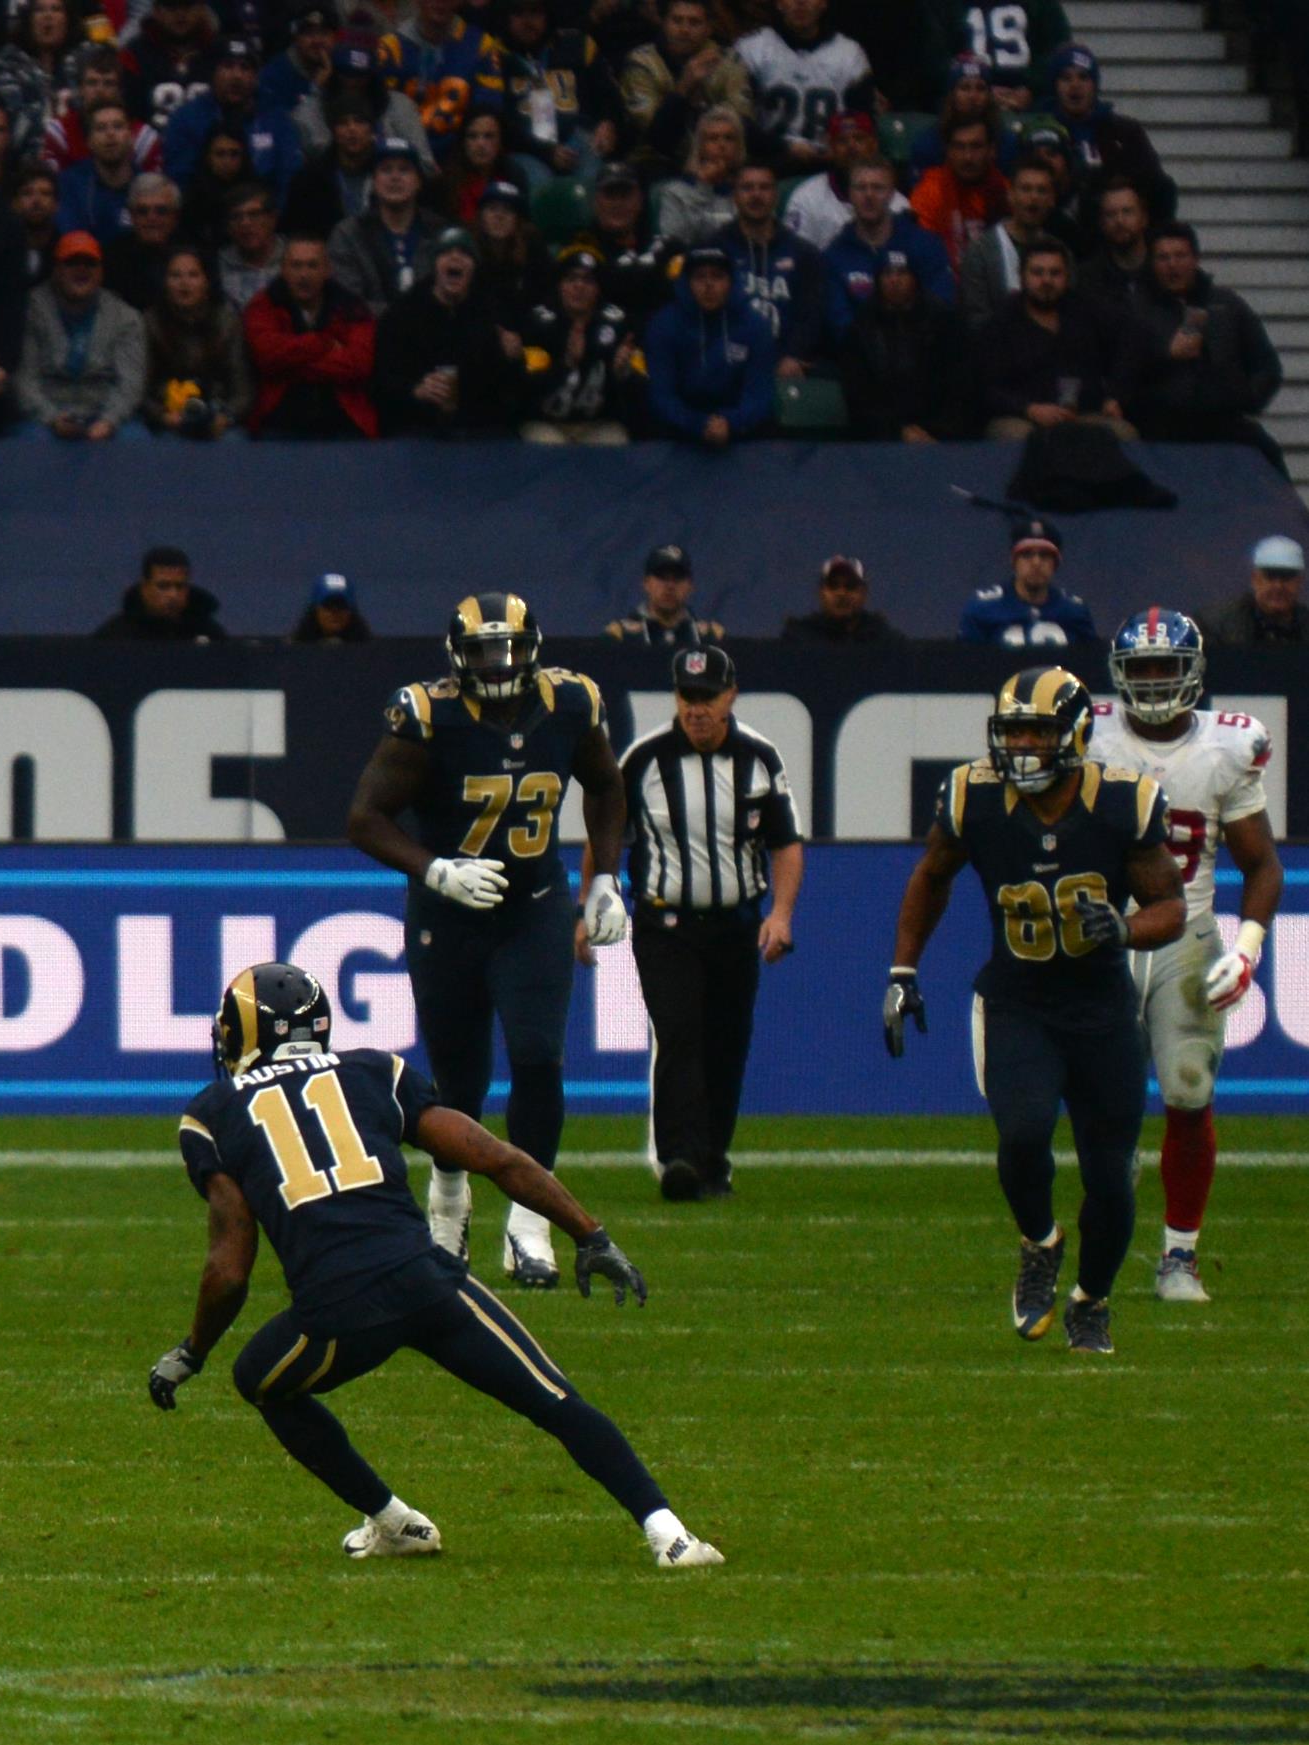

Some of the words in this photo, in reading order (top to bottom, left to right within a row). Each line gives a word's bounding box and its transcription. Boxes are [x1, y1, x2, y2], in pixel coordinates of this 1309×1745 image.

[966, 4, 1031, 69] 19
[1138, 622, 1167, 640] 59
[458, 771, 562, 858] 73
[232, 1052, 341, 1091] AUSTIN
[247, 1069, 385, 1211] 11
[400, 1523, 433, 1541] NIKE
[665, 1536, 690, 1564] NIKE
